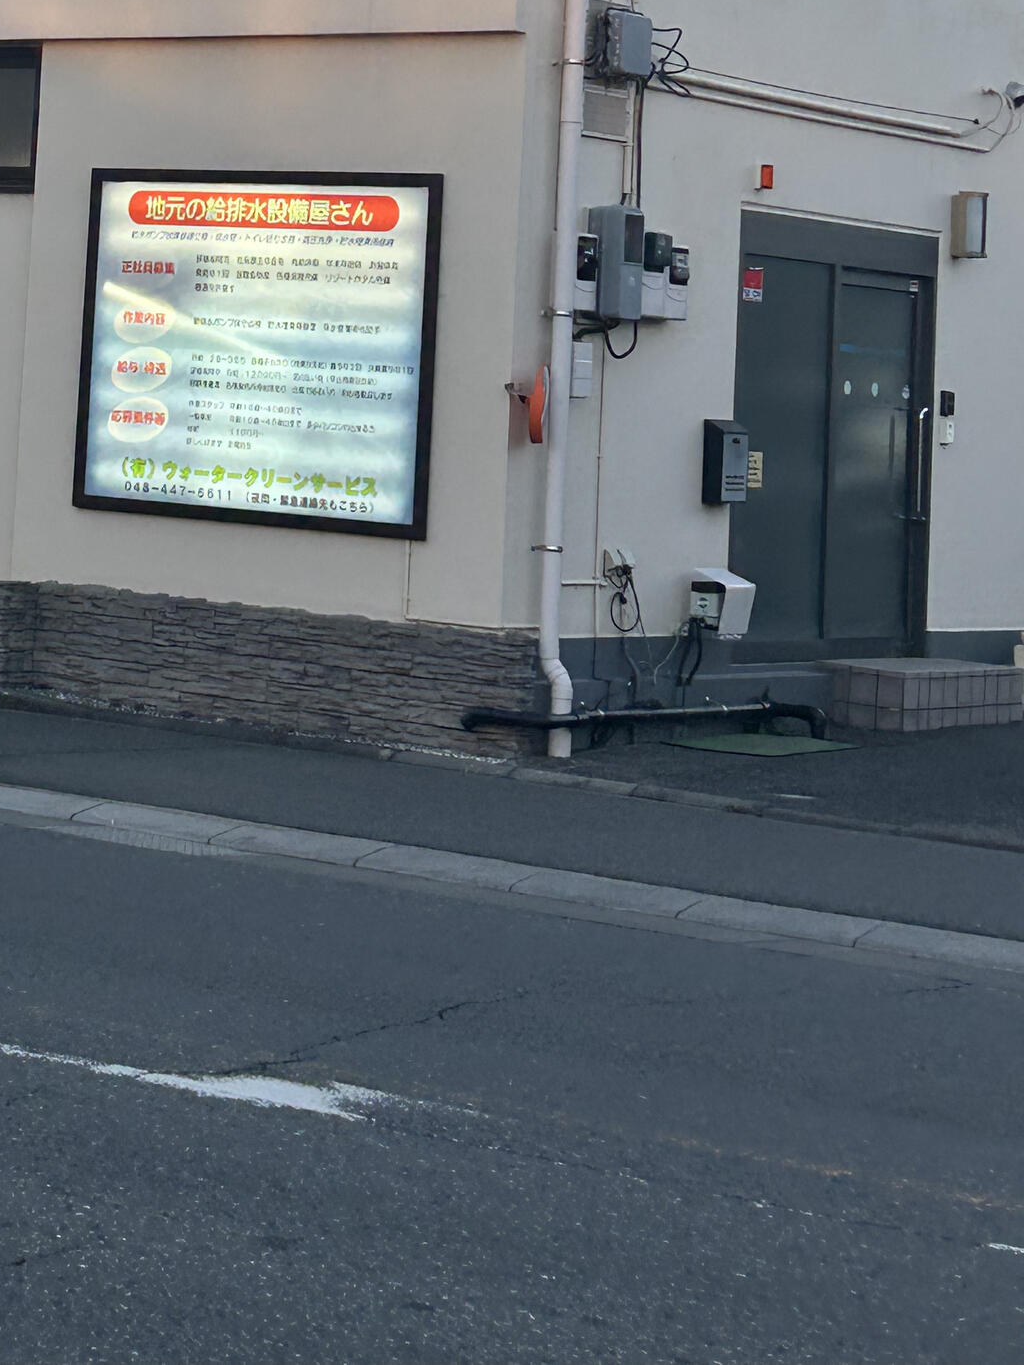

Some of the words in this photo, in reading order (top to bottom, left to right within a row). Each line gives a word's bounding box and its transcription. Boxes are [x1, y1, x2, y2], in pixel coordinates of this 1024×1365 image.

[144, 194, 374, 226] 地元の給排水設備屋さん
